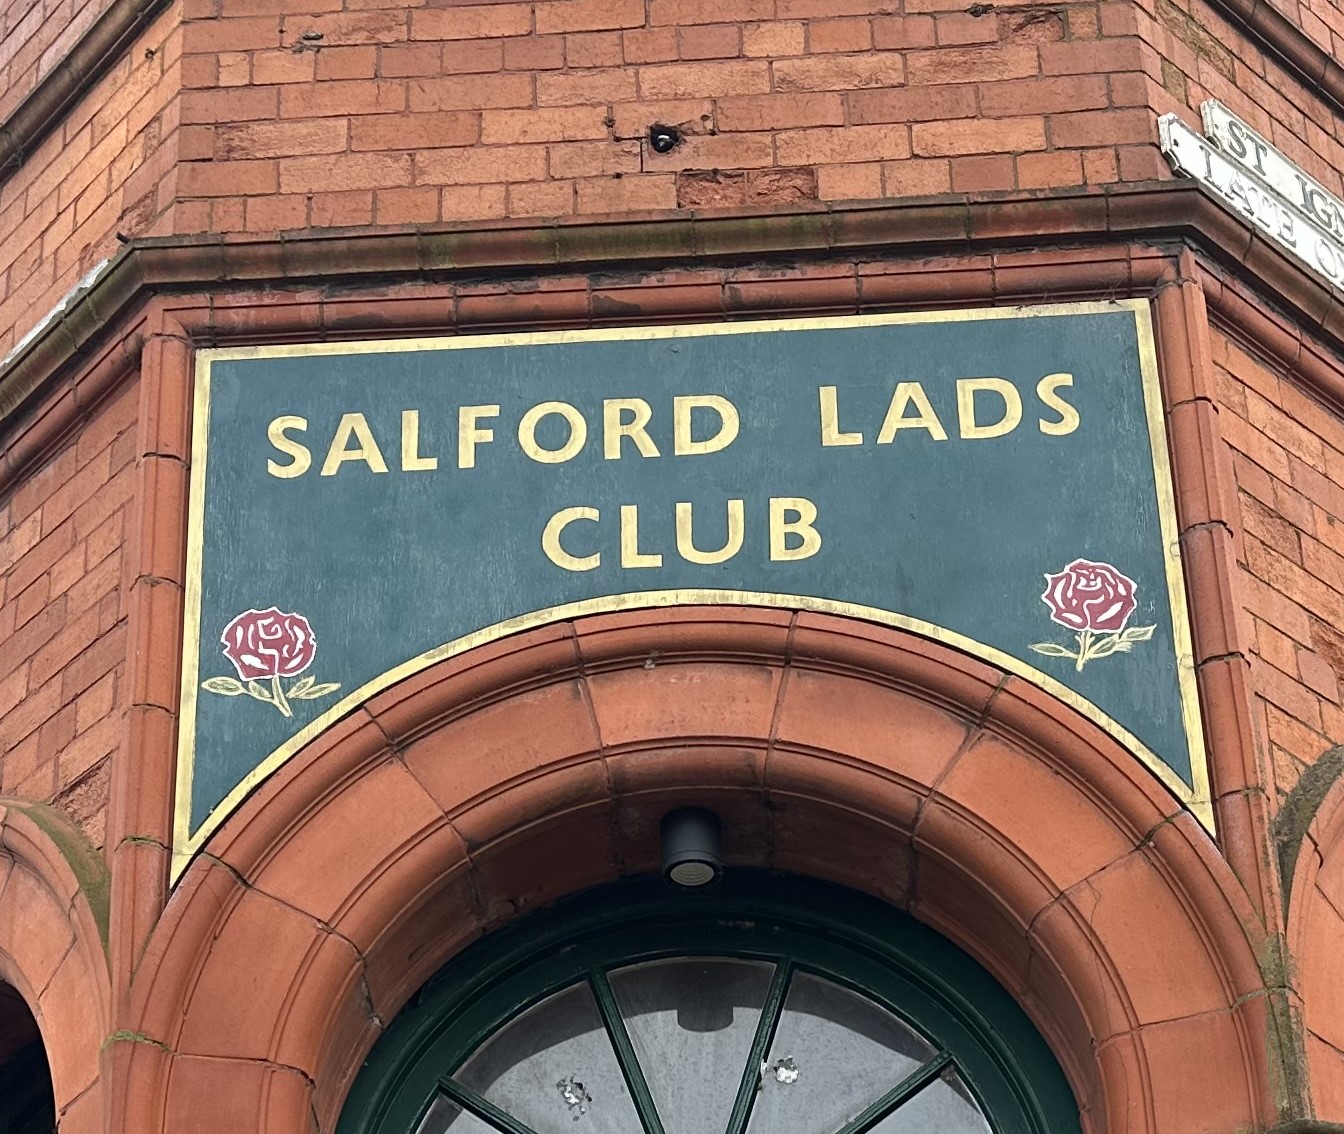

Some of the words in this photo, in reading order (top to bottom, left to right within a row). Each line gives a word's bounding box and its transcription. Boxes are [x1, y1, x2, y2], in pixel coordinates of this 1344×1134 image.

[1227, 120, 1267, 177] ST
[1198, 144, 1297, 249] LATE
[267, 395, 742, 480] SALFORD
[818, 372, 1081, 448] LADS
[542, 497, 823, 573] CLUB
